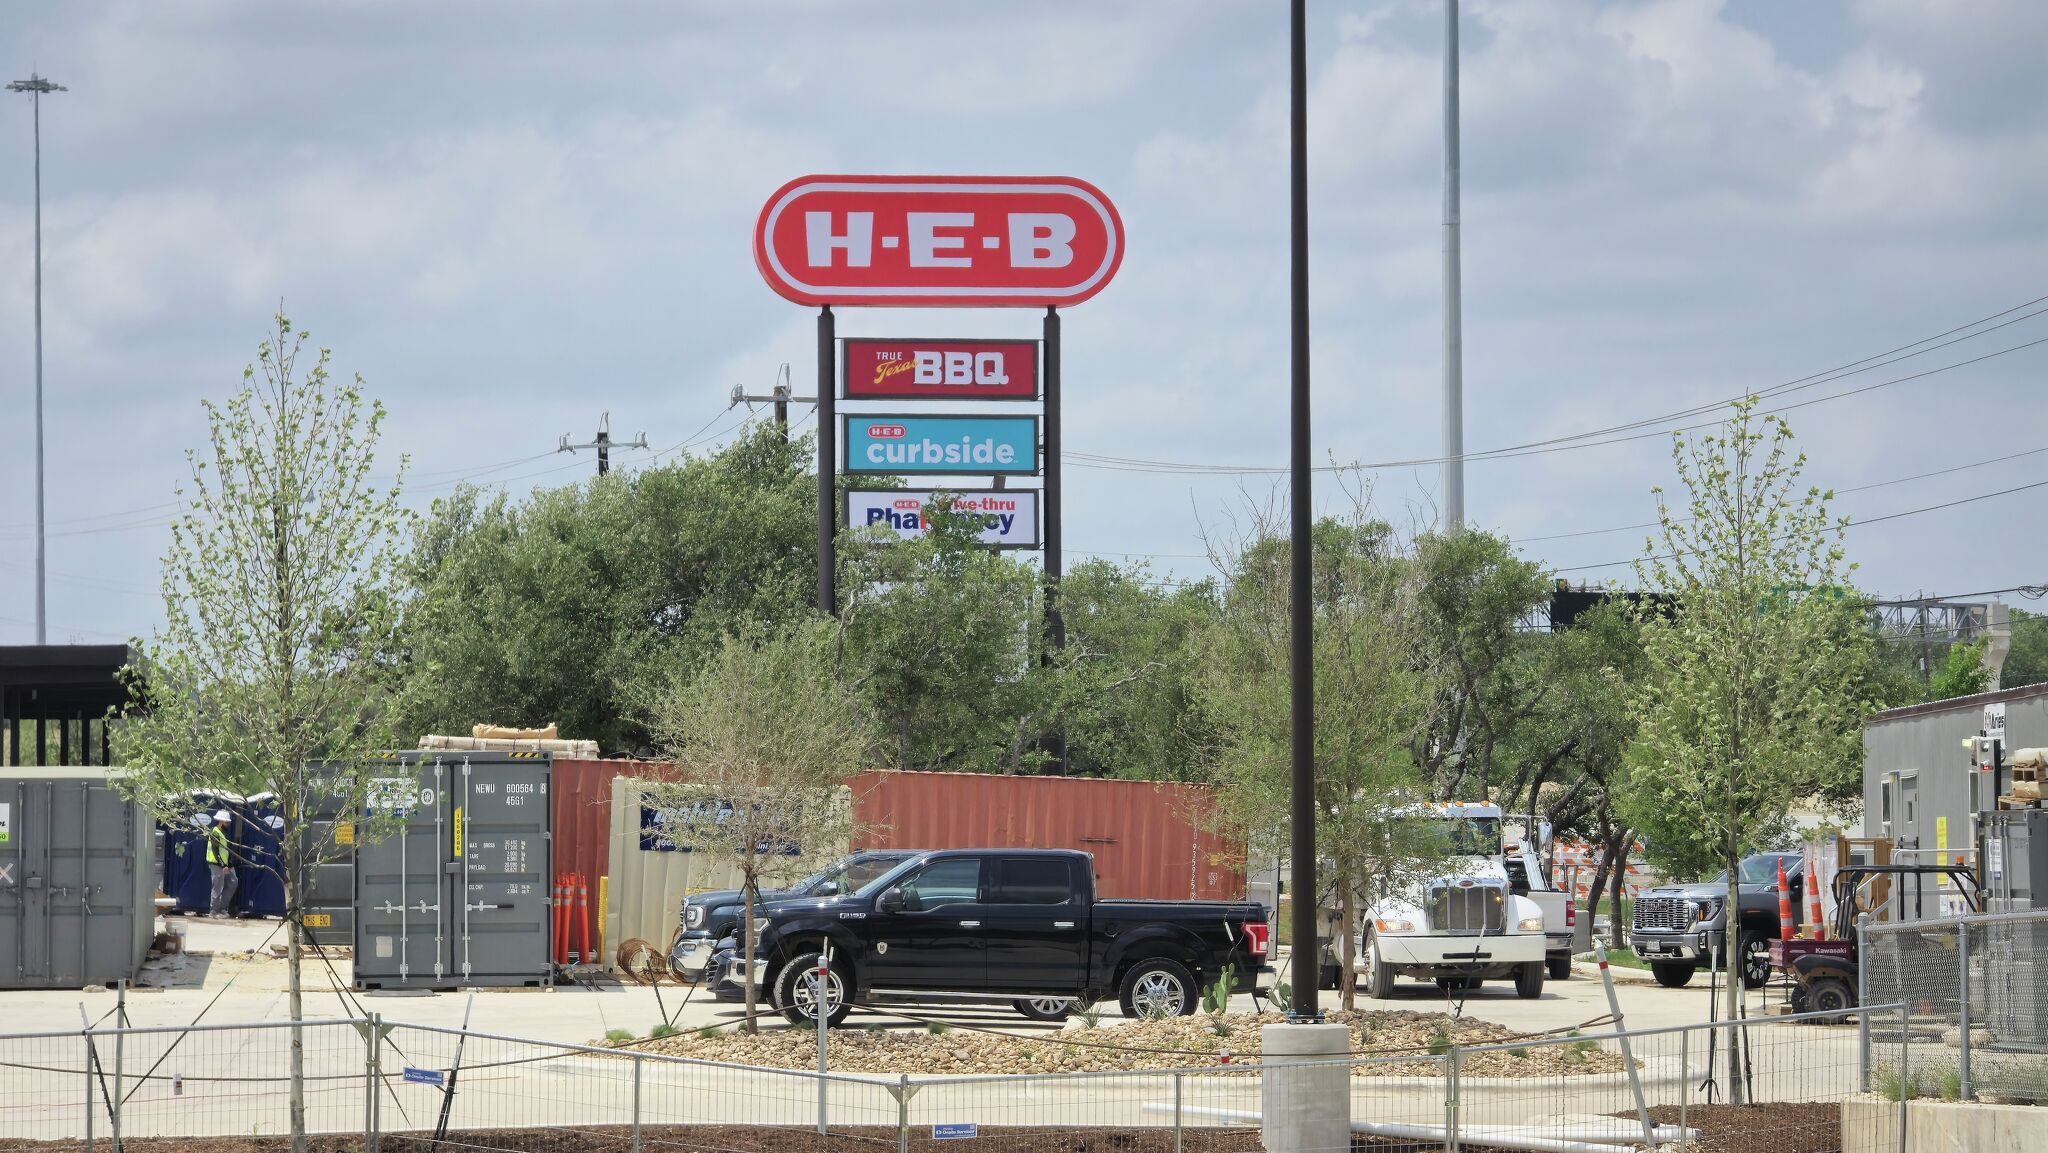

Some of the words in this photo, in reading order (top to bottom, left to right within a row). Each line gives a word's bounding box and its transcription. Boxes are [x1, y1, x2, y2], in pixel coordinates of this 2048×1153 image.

[805, 211, 1077, 268] H-E-B
[874, 358, 917, 384] Texas
[913, 350, 1009, 385] BBQ
[876, 351, 903, 361] TRUE
[866, 435, 1015, 464] curbside
[475, 783, 496, 793] NEWU
[506, 783, 534, 793] 600564
